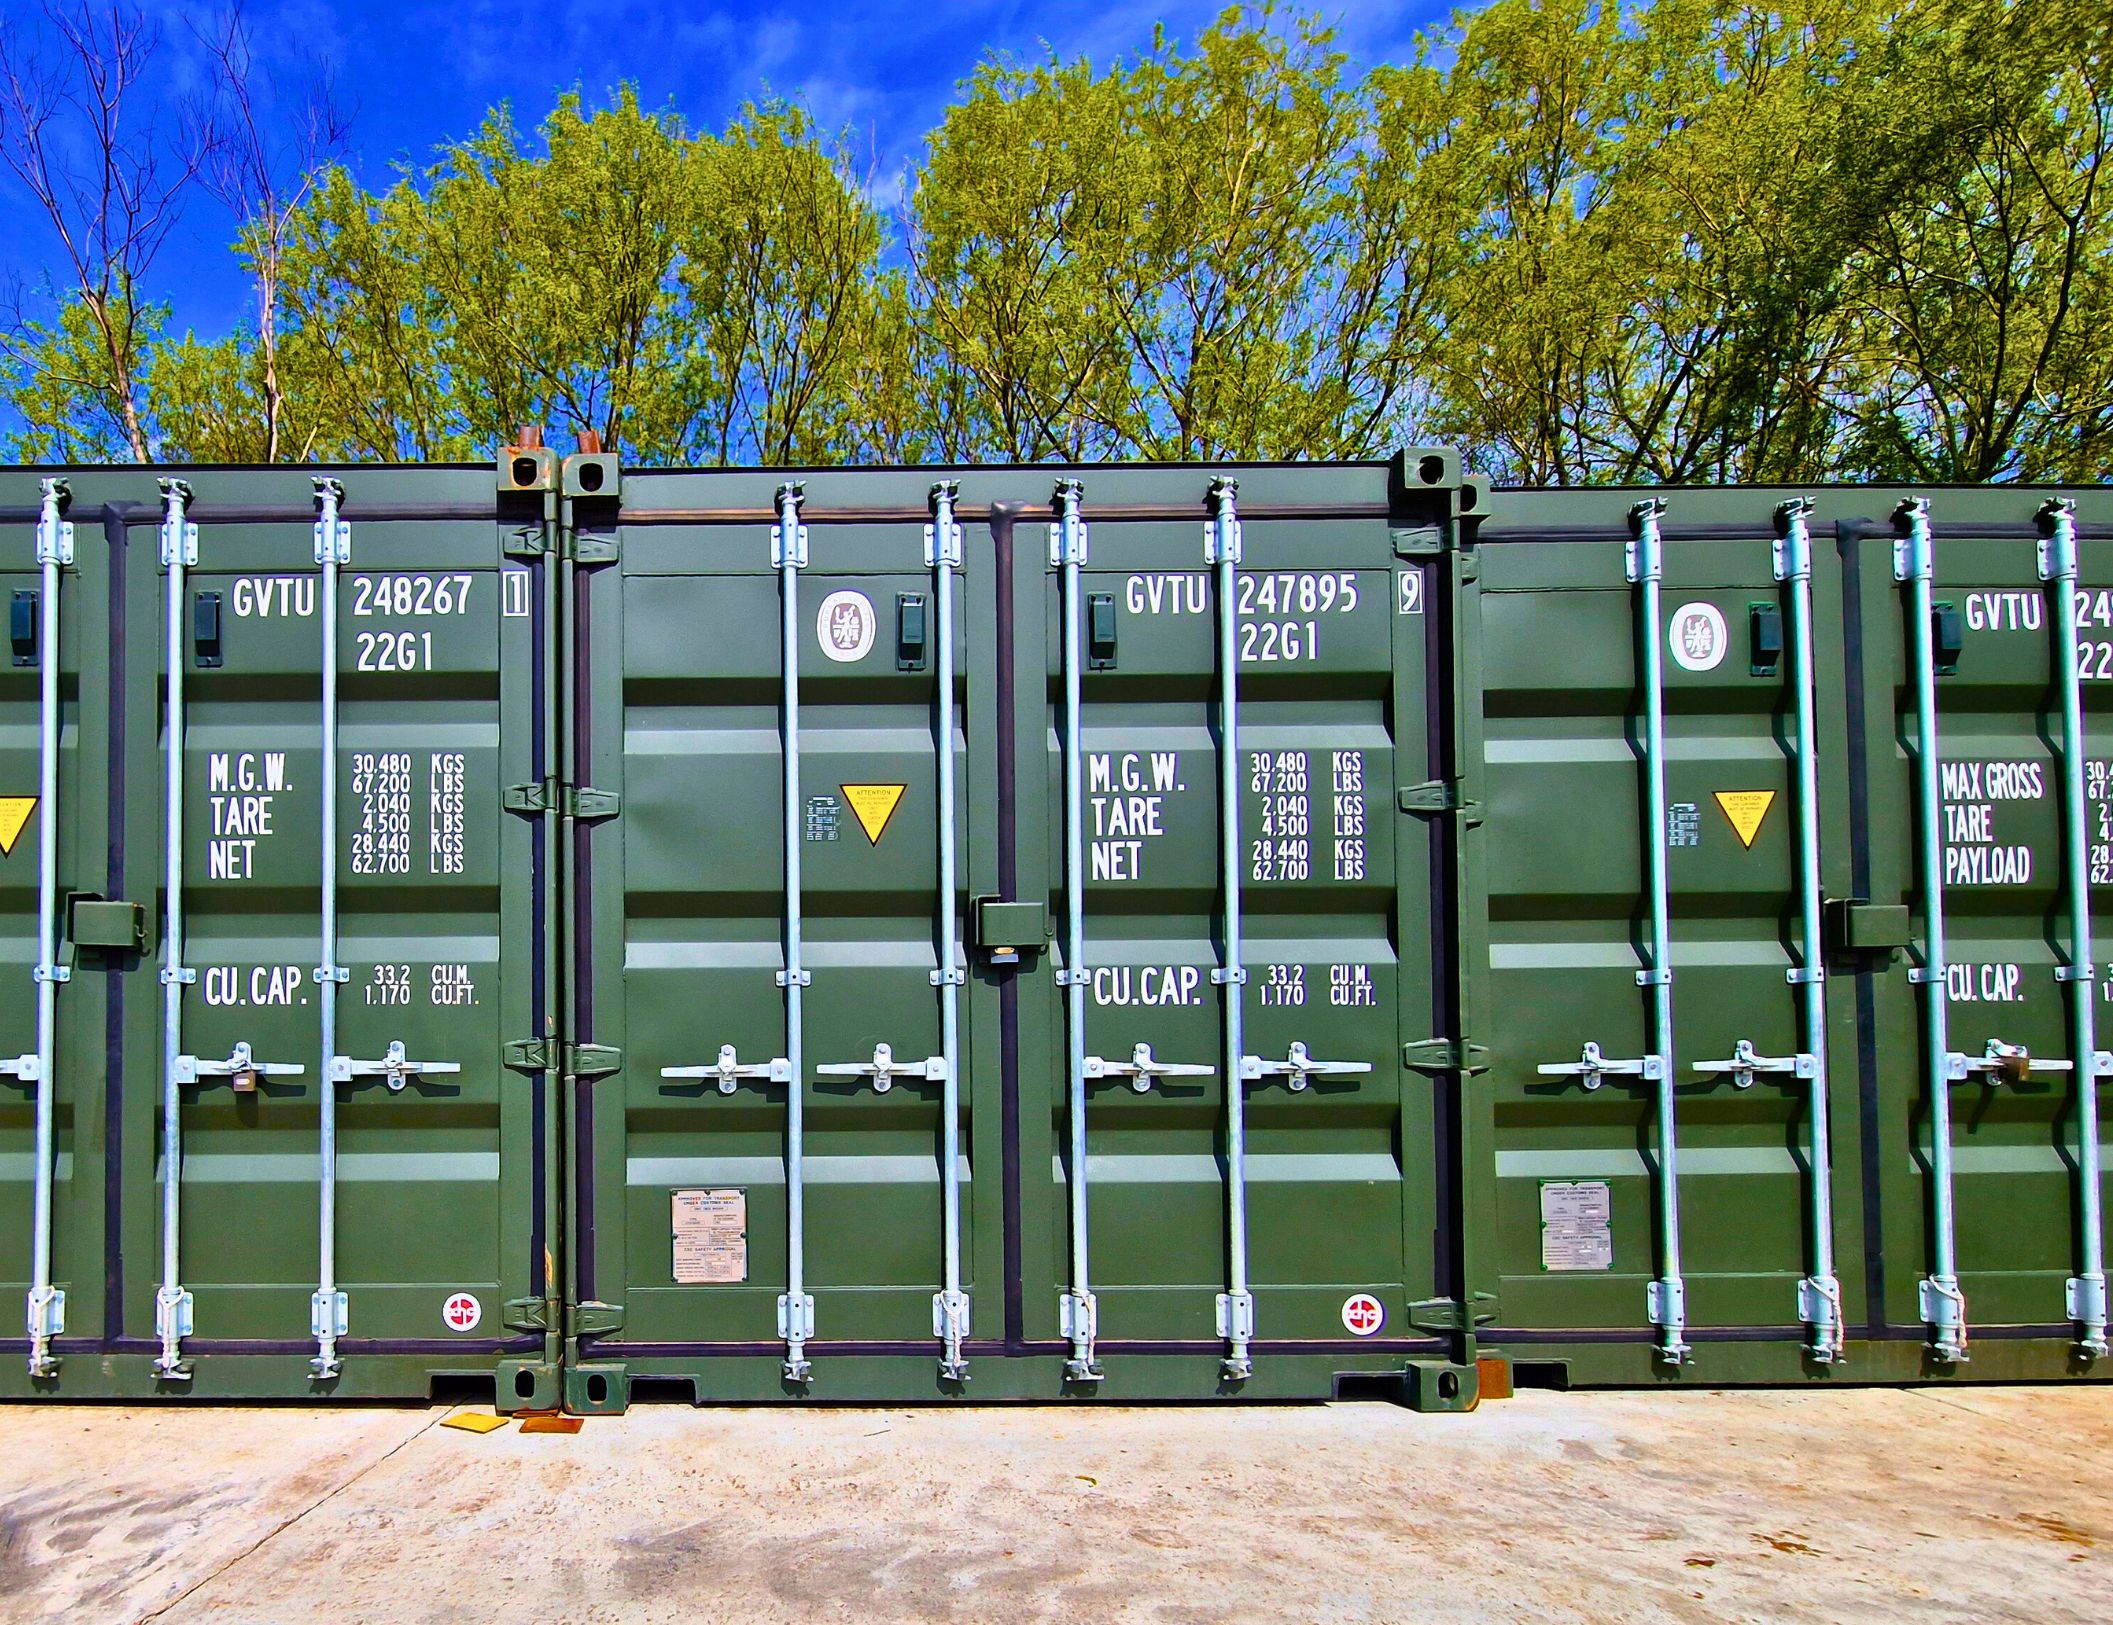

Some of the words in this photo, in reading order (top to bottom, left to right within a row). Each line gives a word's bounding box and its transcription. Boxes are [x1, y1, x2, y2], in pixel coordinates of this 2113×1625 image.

[234, 578, 313, 616] GVTU
[354, 576, 472, 615] 248267
[509, 575, 523, 613] 1
[1127, 573, 1205, 614] GVTU
[1238, 574, 1356, 614] 247895
[1401, 574, 1418, 611] 9
[1966, 594, 2040, 630] GVTU
[2074, 591, 2113, 628] 24
[357, 632, 431, 671] 22G1
[1241, 622, 1315, 661] 22G1
[211, 753, 292, 791] M.G.W.
[432, 754, 464, 774] KGS
[1090, 753, 1184, 792] M.G.W.
[1333, 752, 1360, 771] KGS
[431, 773, 464, 794] LBS
[1334, 772, 1361, 791] LBS
[1942, 763, 1982, 799] MAX
[1986, 763, 2042, 799] GROSS
[211, 797, 272, 835] TARE
[431, 793, 464, 814] KGS
[1091, 797, 1162, 836] TARE
[1334, 796, 1363, 817] KGS
[431, 813, 463, 833] LBS
[1335, 816, 1363, 835] LBS
[1945, 805, 1992, 842] TARE
[431, 833, 463, 853] KGS
[1335, 840, 1363, 861] KGS
[211, 840, 255, 879] NET
[431, 854, 463, 873] LBS
[1092, 841, 1141, 880] NET
[1335, 860, 1363, 879] LBS
[1947, 847, 2029, 884] PAYLOAD
[374, 965, 410, 984] 33.2
[1268, 965, 1302, 984] 33.2
